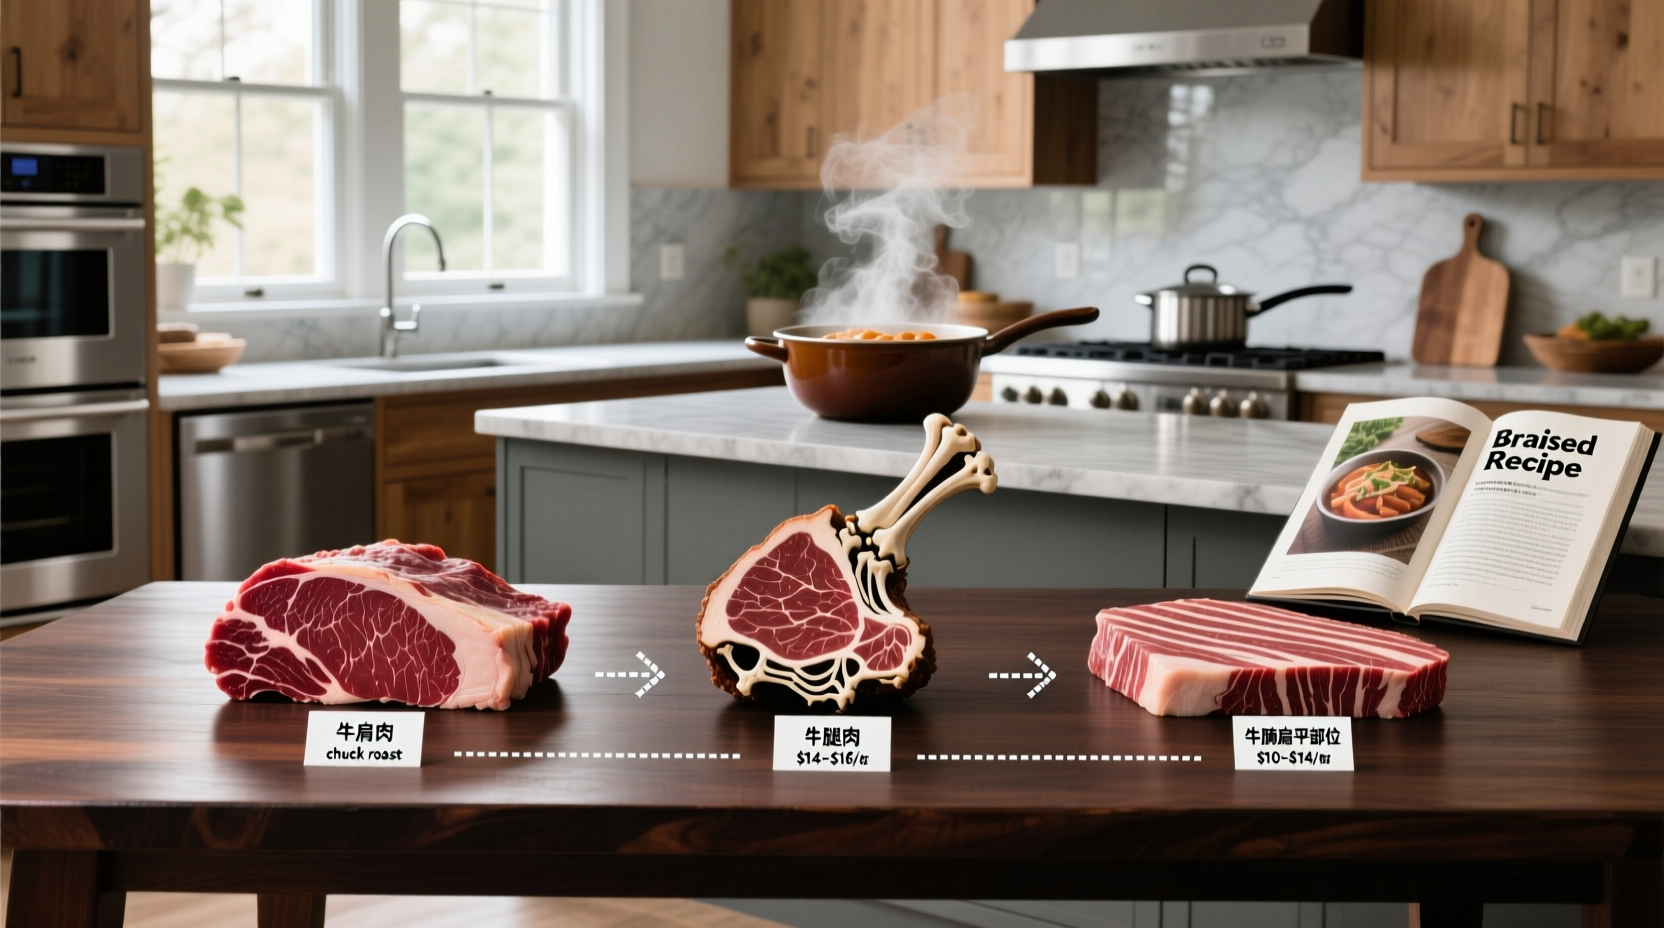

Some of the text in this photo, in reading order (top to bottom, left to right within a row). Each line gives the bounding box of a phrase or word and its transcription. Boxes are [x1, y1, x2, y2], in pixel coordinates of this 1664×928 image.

[1492, 429, 1598, 456] Braised
[1483, 450, 1582, 481] Recipe
[336, 721, 394, 743] 牛肩肉
[805, 726, 860, 747] 牛腿肉
[326, 746, 403, 761] chuck roast
